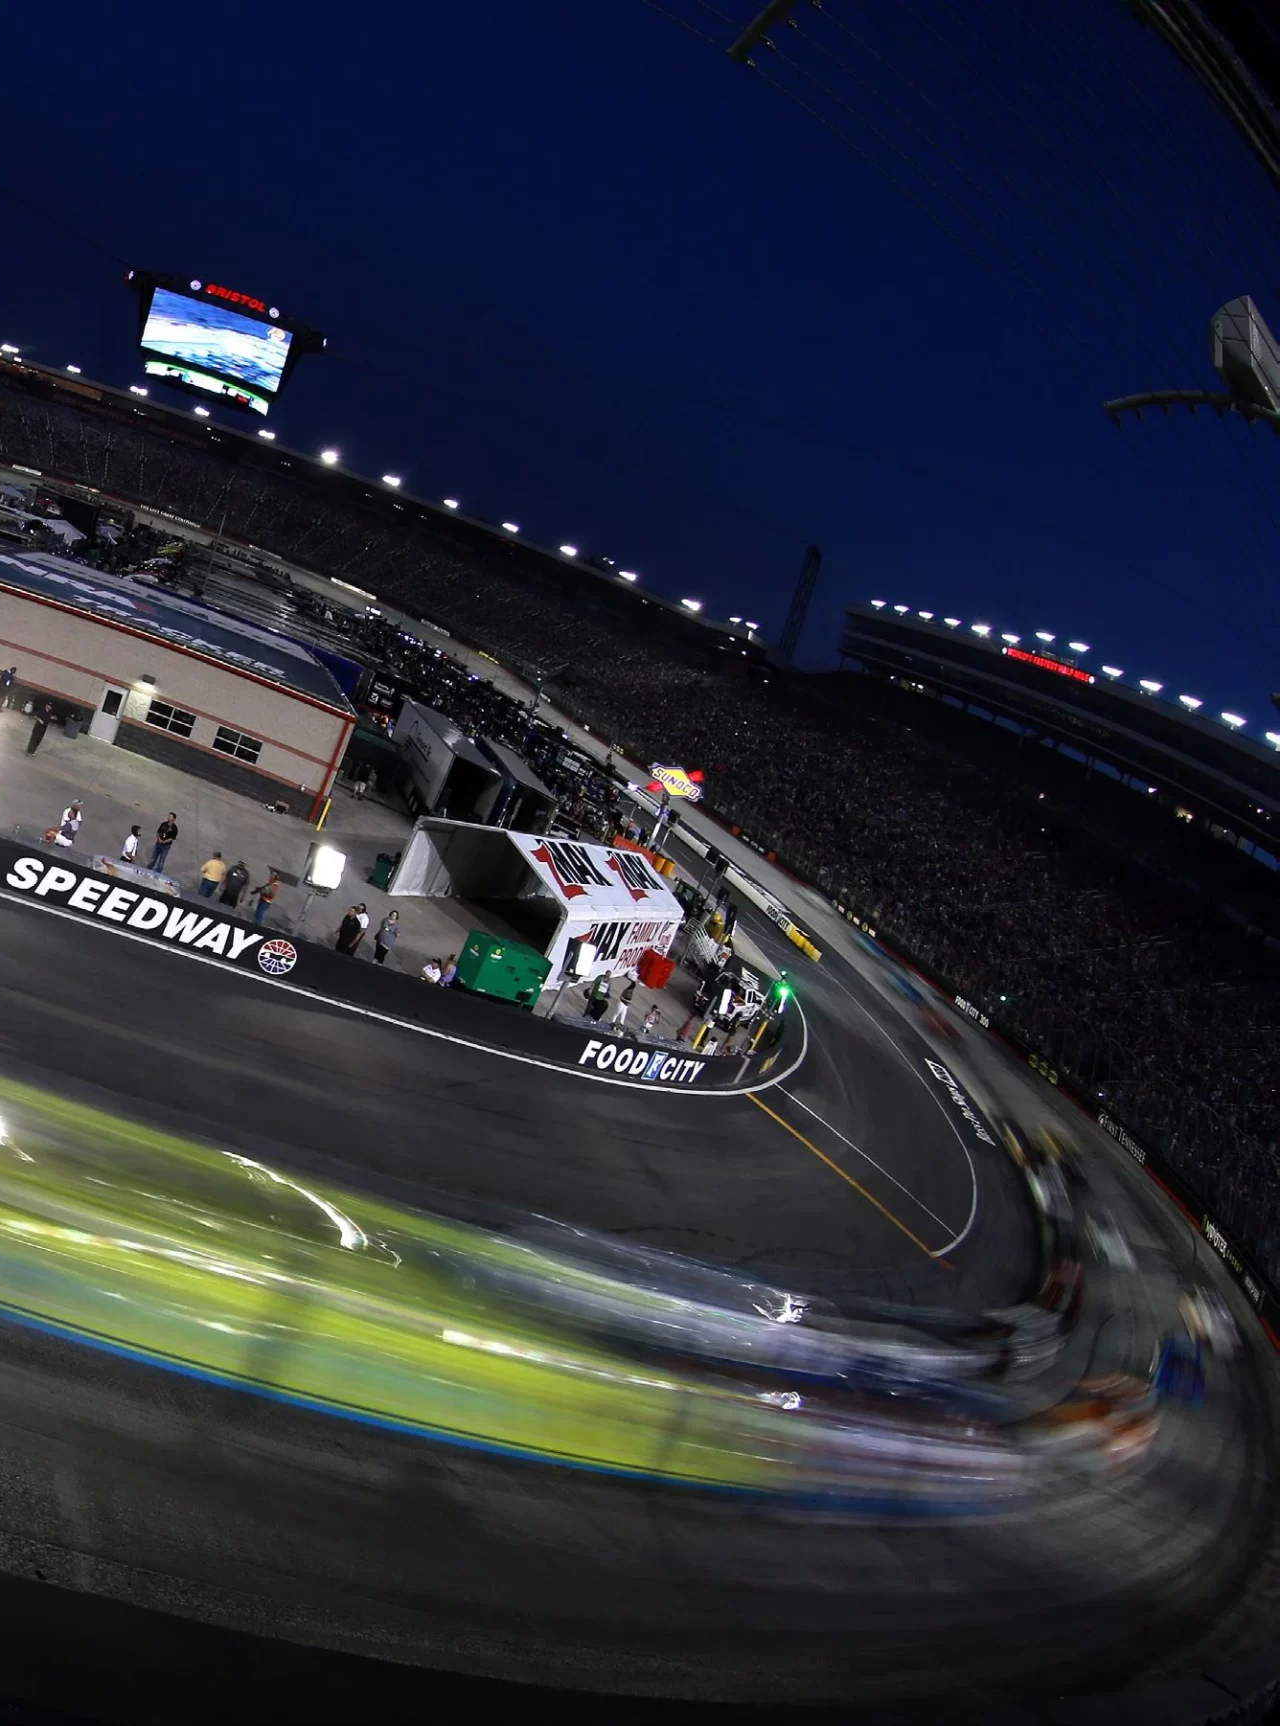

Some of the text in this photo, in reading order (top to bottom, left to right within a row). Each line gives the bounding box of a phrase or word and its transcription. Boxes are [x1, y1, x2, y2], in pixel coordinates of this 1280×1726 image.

[206, 284, 265, 312] BRISTOL
[654, 768, 699, 797] SUNOCO
[5, 855, 263, 963] SPEEDWAY
[626, 922, 662, 944] FAMILY
[578, 1039, 706, 1083] FOOD CITY
